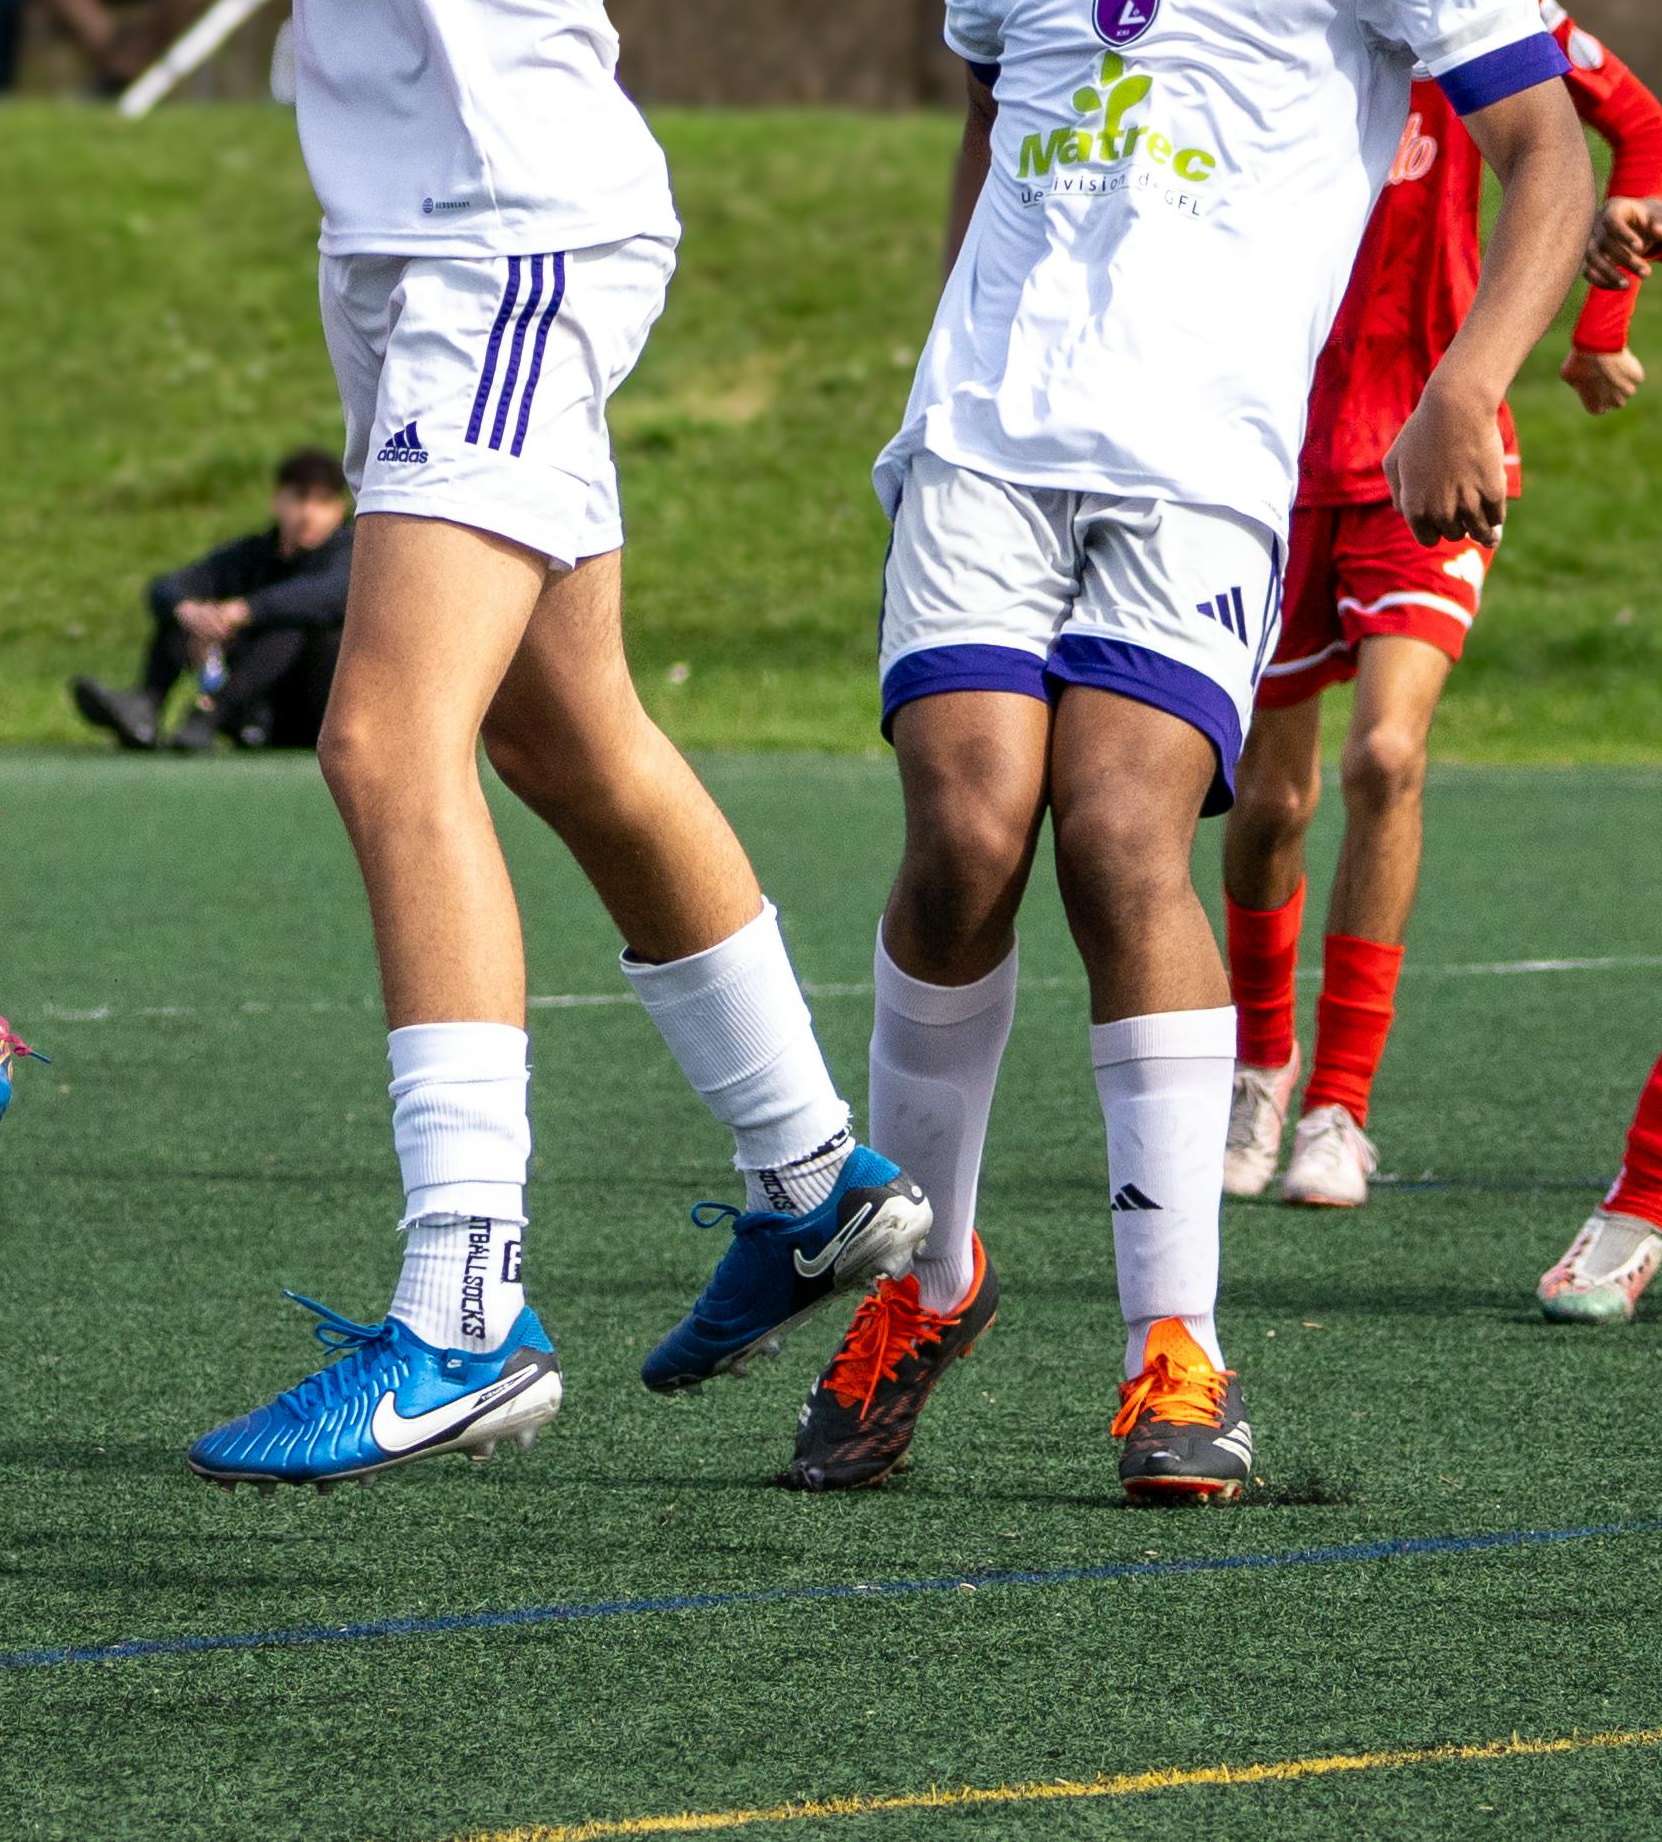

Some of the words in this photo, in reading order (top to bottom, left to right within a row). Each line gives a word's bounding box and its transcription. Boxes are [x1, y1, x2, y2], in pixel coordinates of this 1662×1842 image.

[1016, 124, 1216, 182] Matrec
[1052, 172, 1125, 193] ivision
[1164, 189, 1202, 216] GFL
[376, 447, 430, 464] adidas
[460, 1215, 492, 1340] TBALLSOCKS
